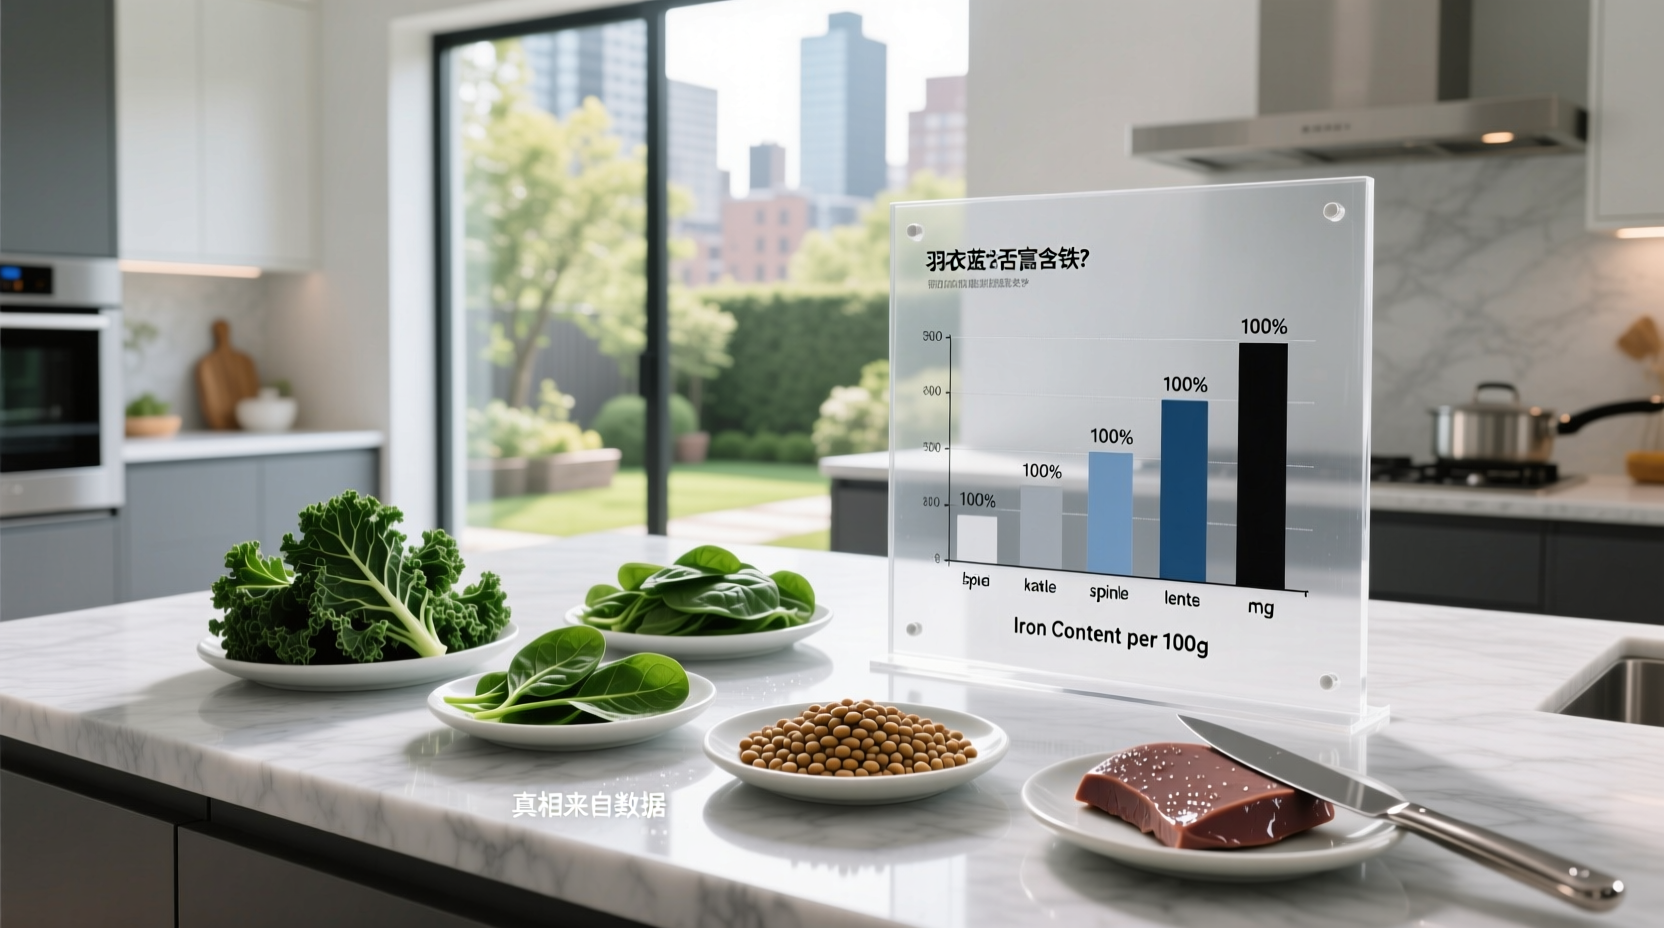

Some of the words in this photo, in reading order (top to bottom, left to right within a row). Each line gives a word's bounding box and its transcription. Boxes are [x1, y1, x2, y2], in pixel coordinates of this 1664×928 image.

[1241, 317, 1288, 335] 100%
[1163, 376, 1209, 393] 100%
[1090, 428, 1134, 445] 100%
[1022, 462, 1063, 480] 100%
[959, 491, 997, 508] 100%
[1248, 601, 1275, 619] mg
[1014, 616, 1047, 636] Iron
[1051, 620, 1122, 645] Content
[1127, 632, 1158, 650] per
[1163, 633, 1209, 659] 100g
